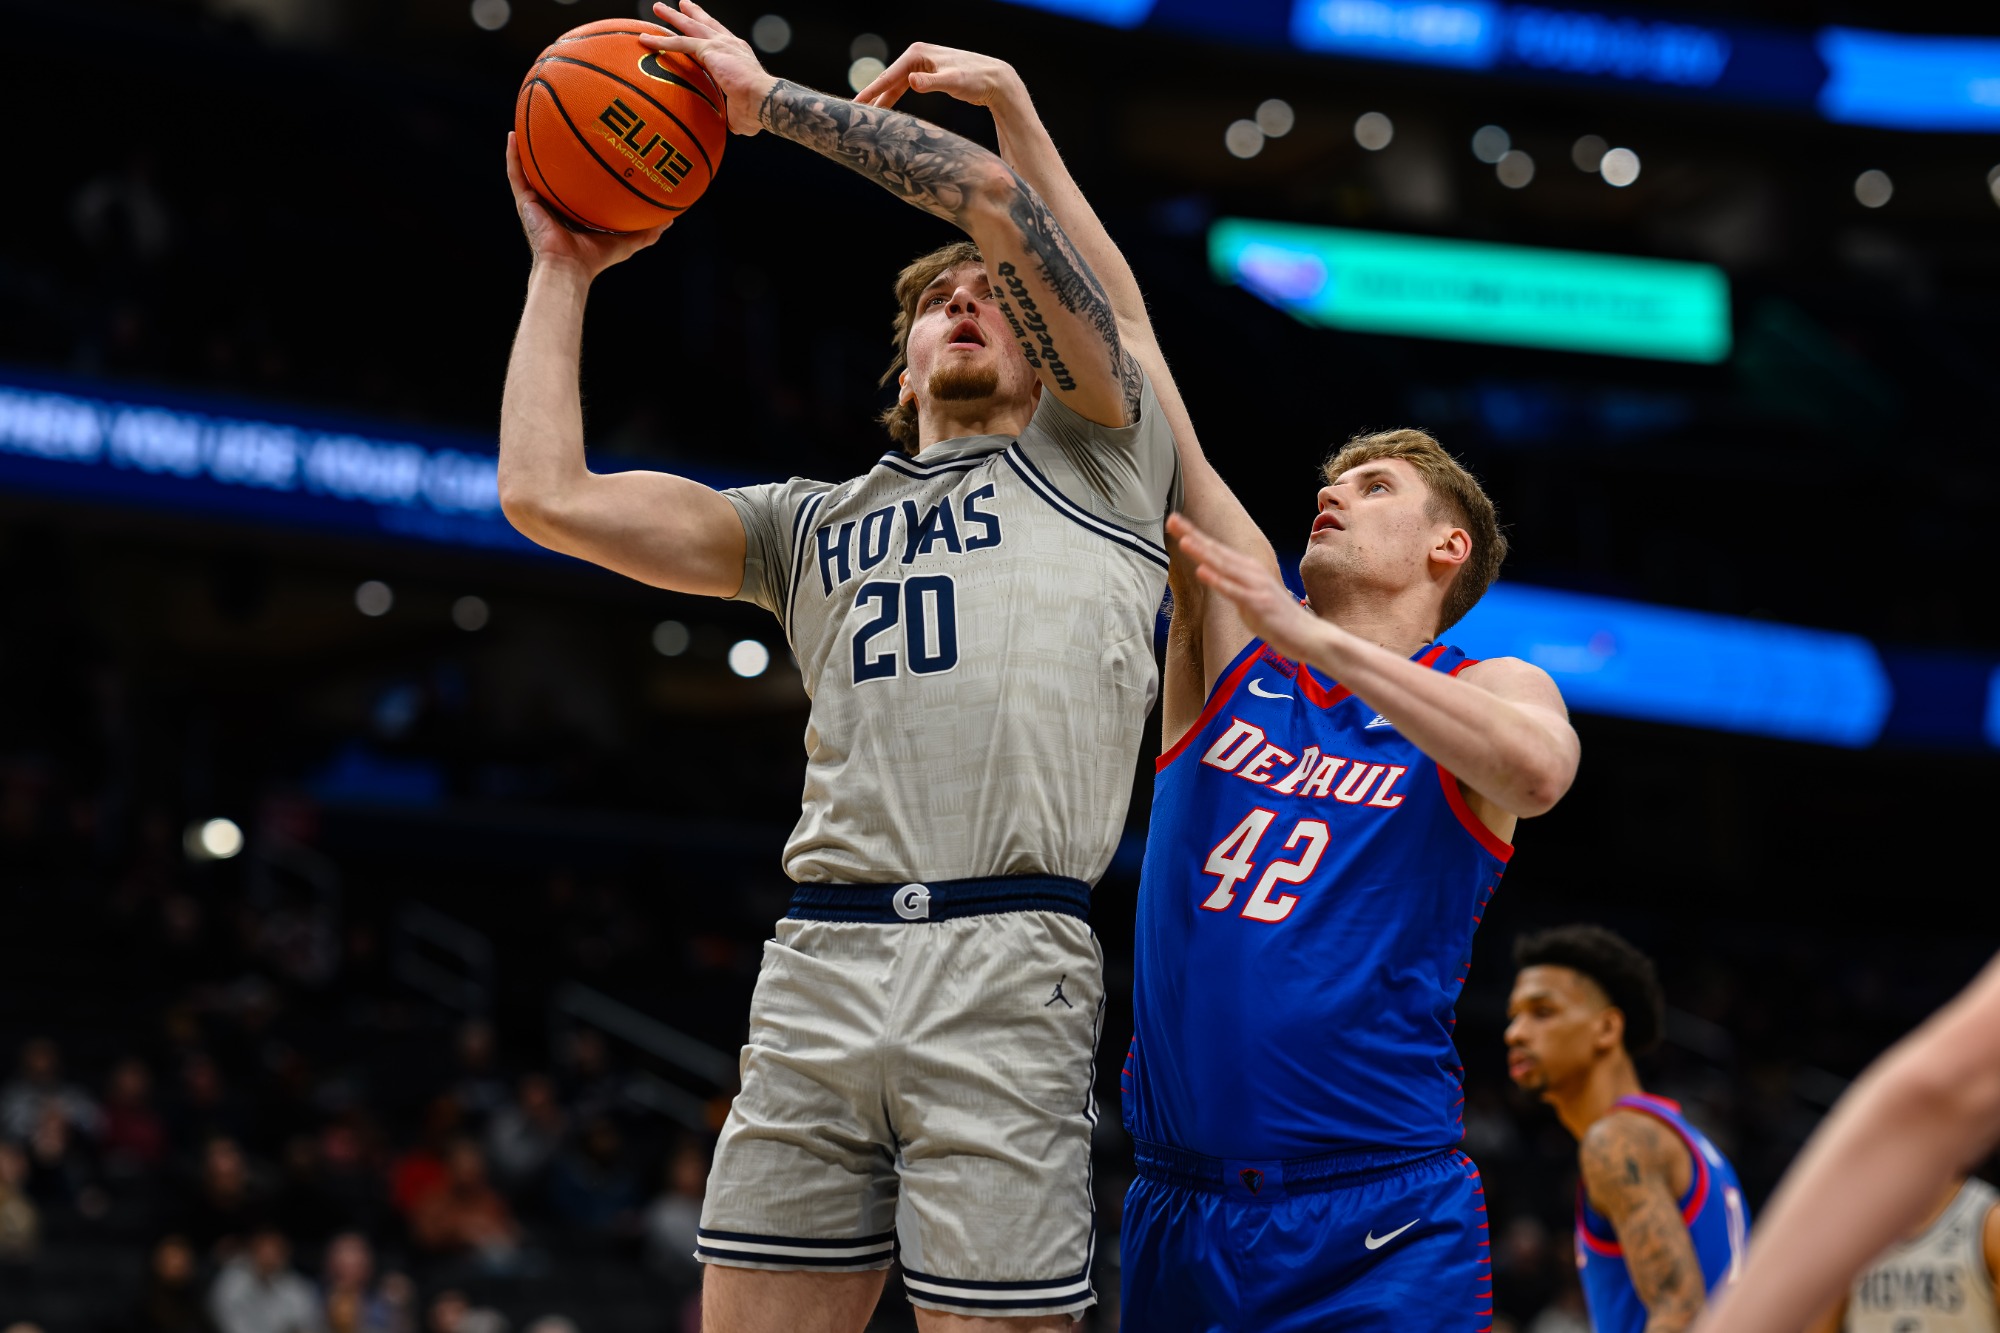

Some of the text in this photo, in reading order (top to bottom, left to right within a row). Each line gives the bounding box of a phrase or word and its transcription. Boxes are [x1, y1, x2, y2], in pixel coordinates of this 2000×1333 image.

[592, 121, 673, 193] CHAMPIONSHIP
[598, 96, 695, 188] ELITE
[998, 261, 1077, 391] undefeated
[1000, 301, 1027, 339] work
[1021, 340, 1043, 369] The
[815, 481, 1002, 601] HOYAS
[852, 572, 960, 688] 20
[893, 883, 932, 920] G
[1200, 806, 1332, 923] 42
